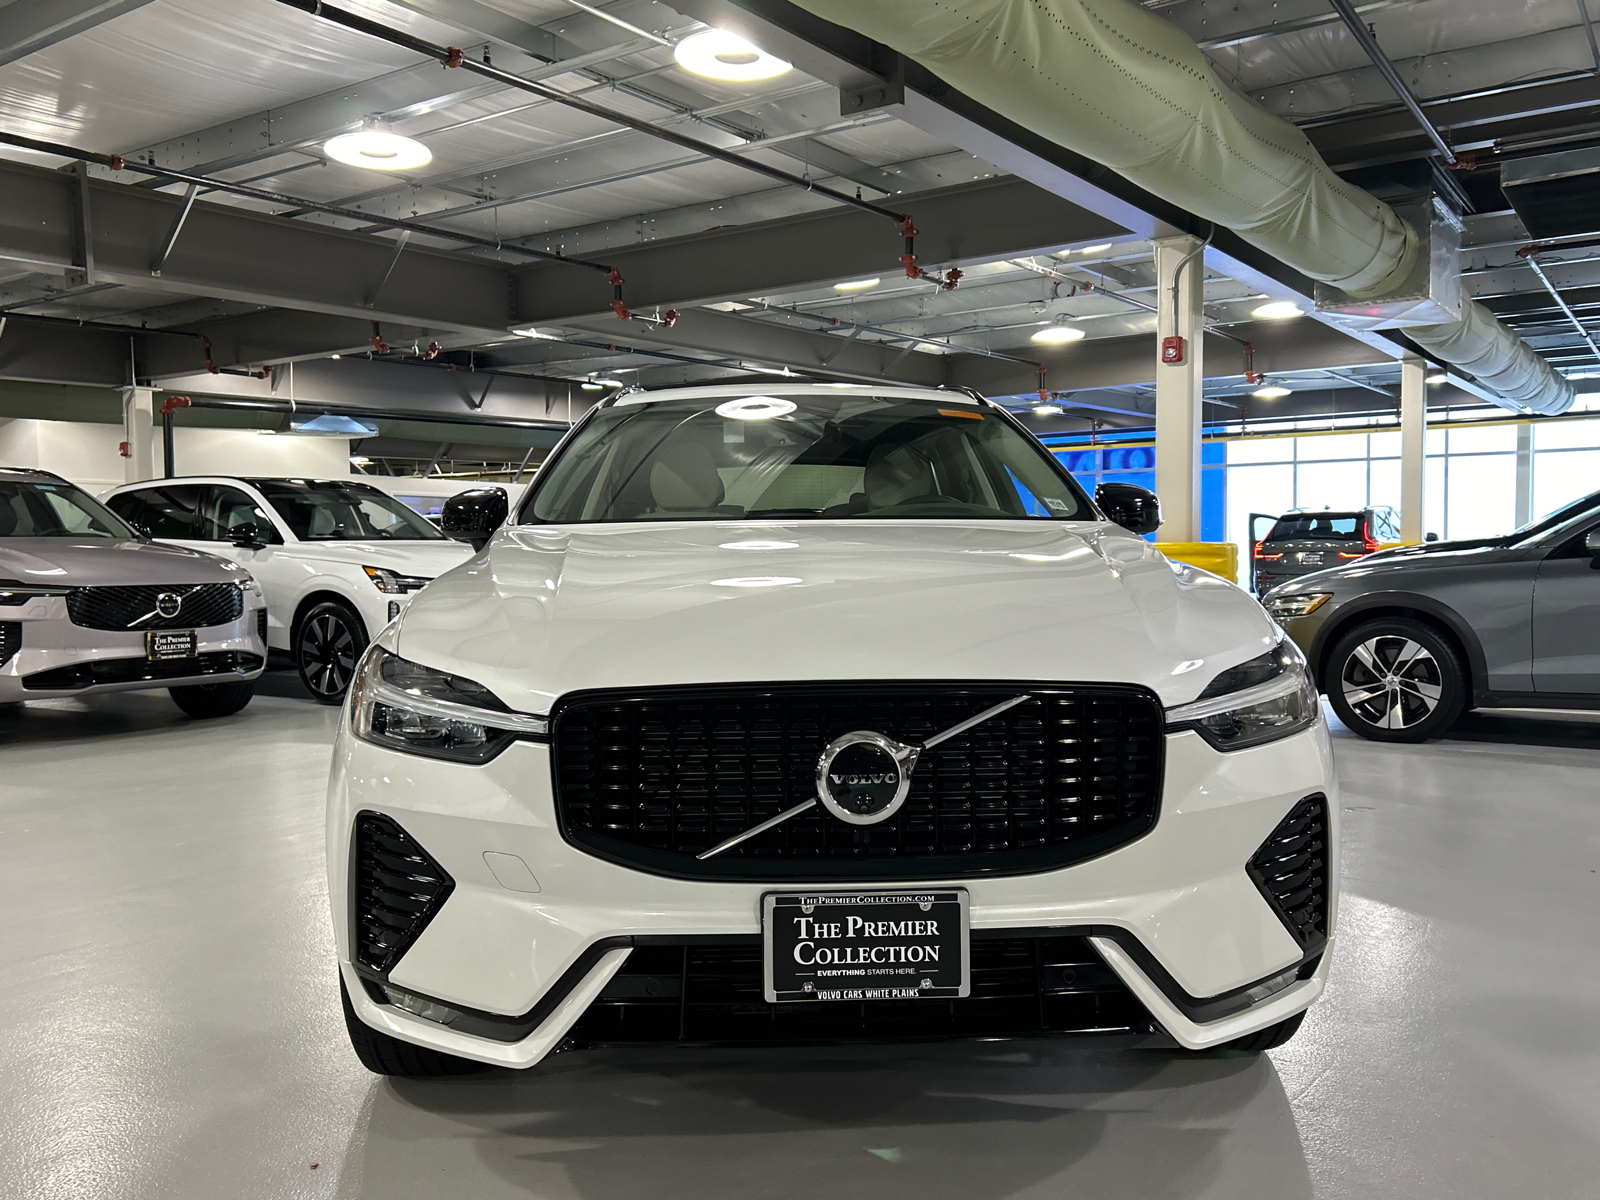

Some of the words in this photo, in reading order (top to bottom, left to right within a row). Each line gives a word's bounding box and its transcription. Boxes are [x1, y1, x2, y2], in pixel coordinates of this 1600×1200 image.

[830, 773, 898, 785] VOLVO
[793, 916, 842, 939] THE
[845, 915, 940, 938] PREMIER
[793, 941, 940, 965] COLLECTION
[817, 969, 866, 977] EVERYTHING
[866, 968, 895, 976] STARTS
[817, 990, 841, 1000] VOLVO
[843, 990, 863, 999] CARS
[865, 989, 890, 998] WHITE
[892, 988, 920, 998] PLAINS
